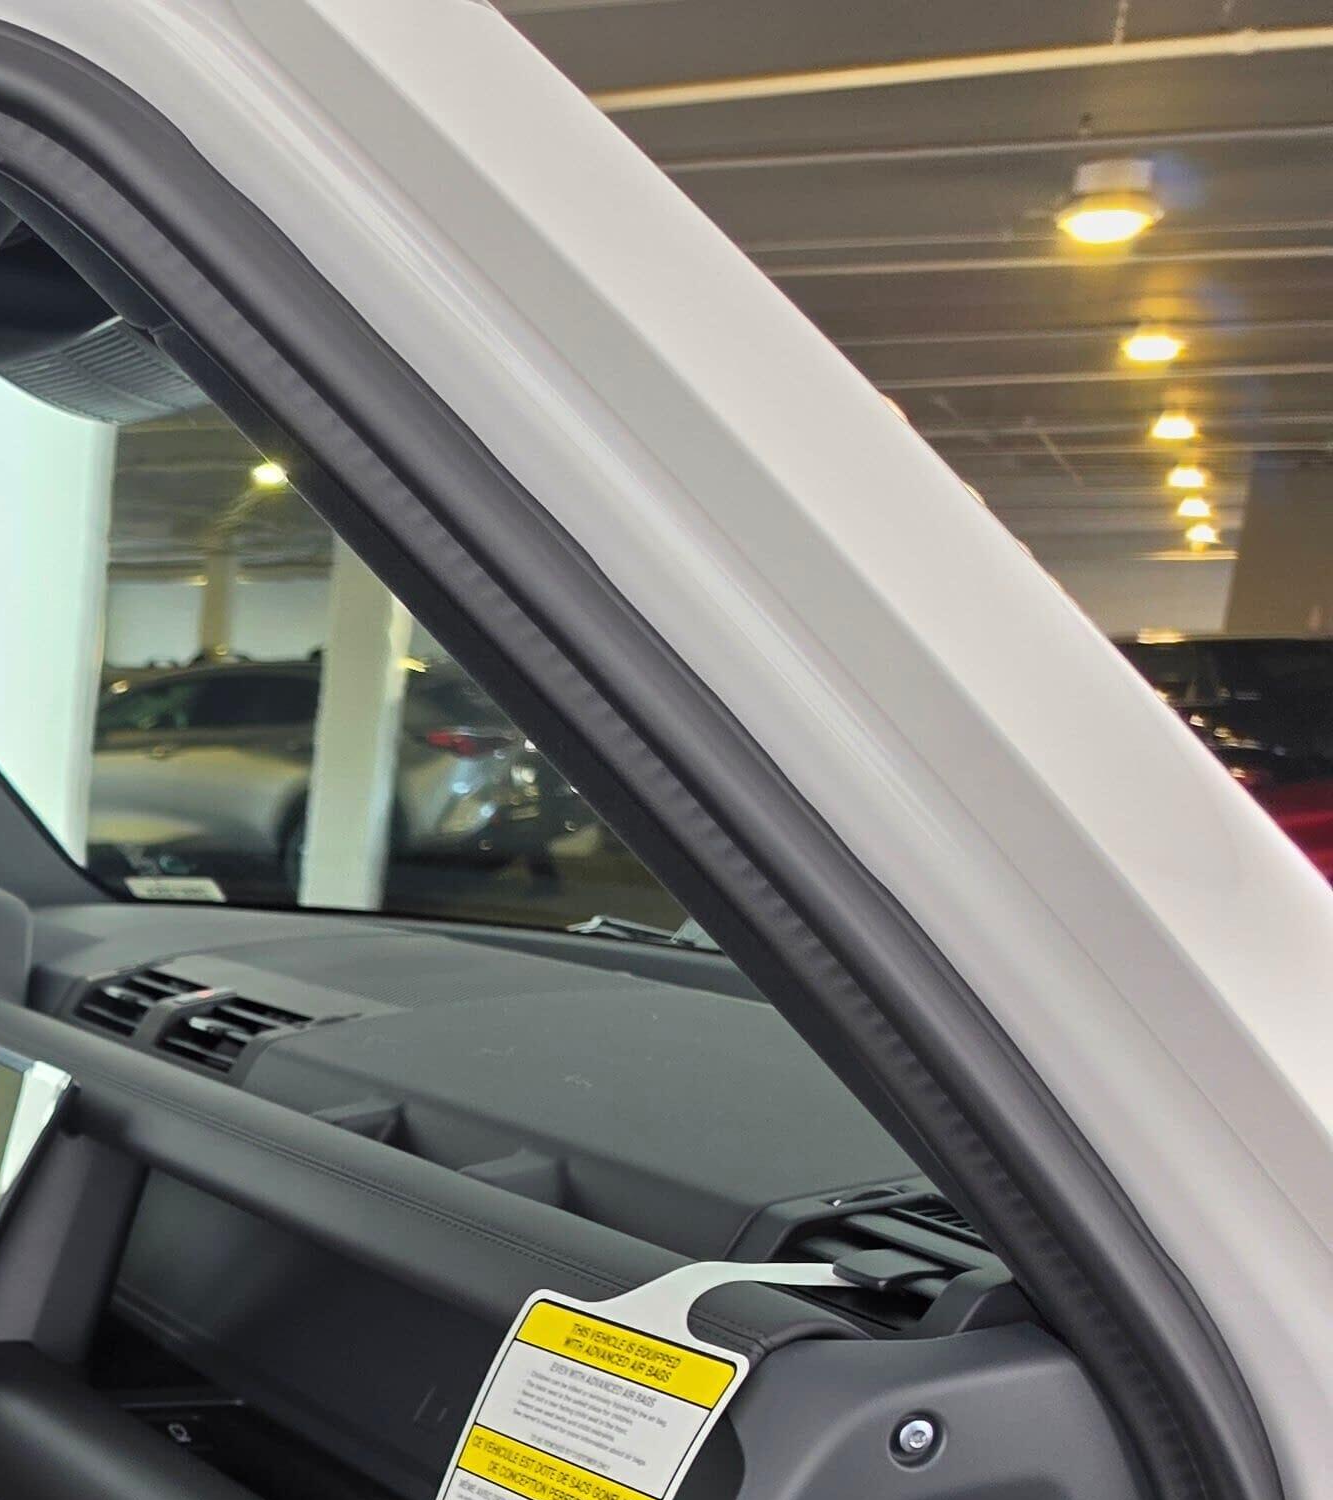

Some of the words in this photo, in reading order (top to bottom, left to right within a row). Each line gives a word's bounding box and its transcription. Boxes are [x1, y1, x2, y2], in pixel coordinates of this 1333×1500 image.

[561, 1336, 584, 1352] WITH
[583, 1343, 630, 1368] ADVANCED
[629, 1359, 647, 1374] AIR
[644, 1365, 672, 1383] BAGS
[569, 1322, 591, 1338] THIS
[589, 1329, 626, 1350] VEHICLE
[623, 1341, 636, 1354] IS
[633, 1344, 682, 1369] EQUIPPED
[486, 1459, 499, 1474] DE
[498, 1464, 547, 1495] CONCEPTION
[518, 1454, 535, 1470] EST
[556, 1470, 570, 1485] DE
[568, 1475, 592, 1495] SACS
